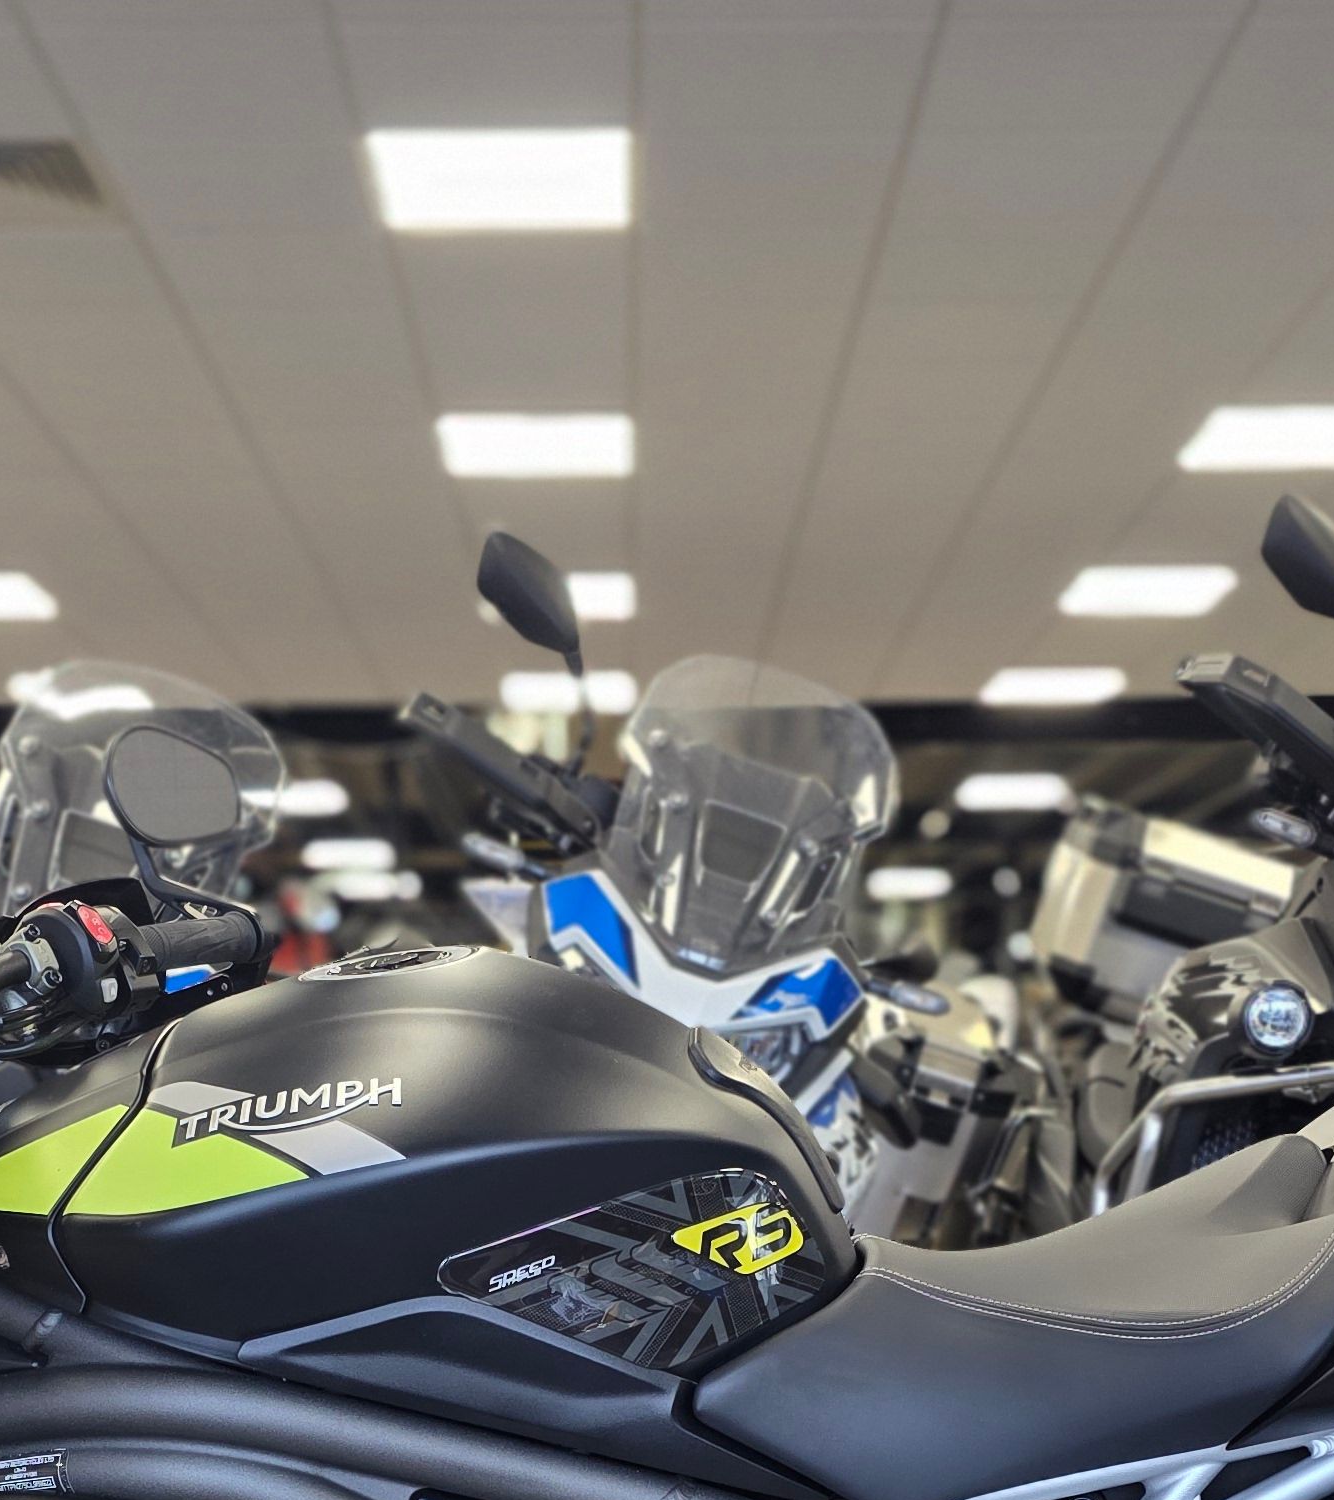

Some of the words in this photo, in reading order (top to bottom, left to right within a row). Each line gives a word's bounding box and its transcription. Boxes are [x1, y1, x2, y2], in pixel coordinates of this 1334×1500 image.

[178, 1076, 403, 1141] TRIUMPH
[700, 1202, 792, 1269] RS
[488, 1255, 556, 1293] SPEED
